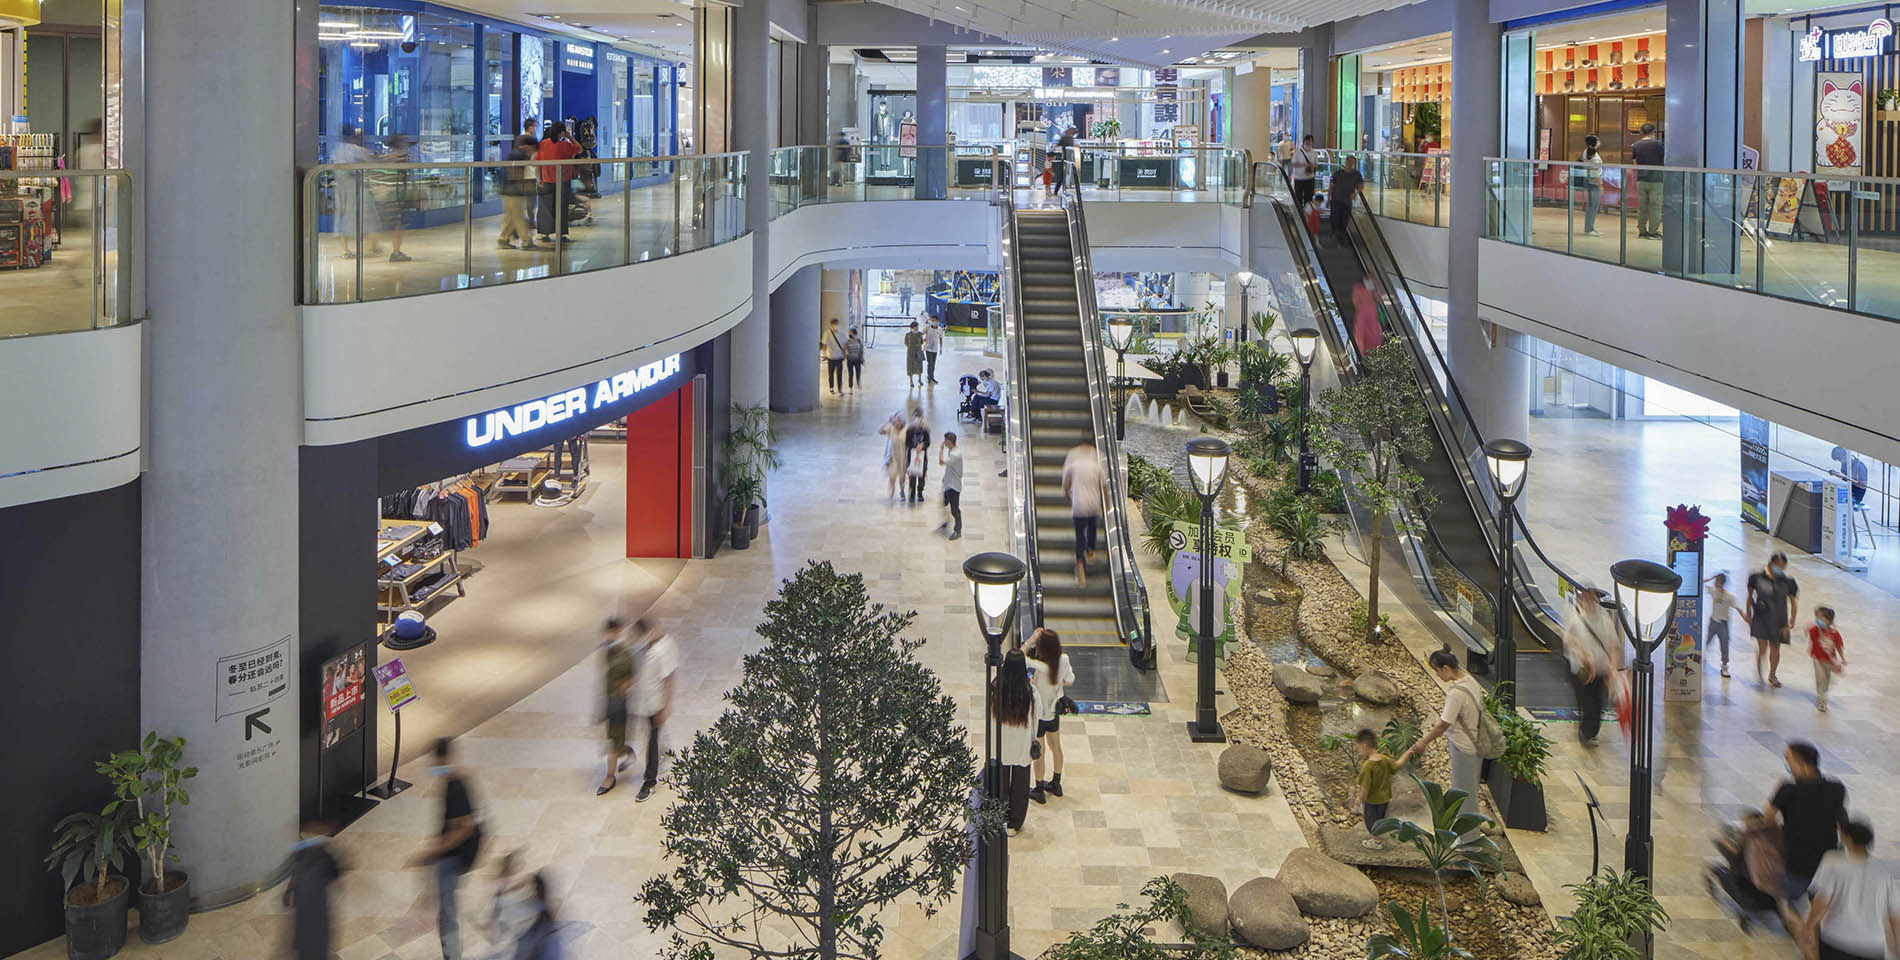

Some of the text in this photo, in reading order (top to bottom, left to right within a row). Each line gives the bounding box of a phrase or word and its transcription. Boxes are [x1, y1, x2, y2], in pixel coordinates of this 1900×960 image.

[467, 353, 680, 447] UNDER ARMOUR
[1188, 525, 1236, 545] 加会员
[330, 685, 358, 708] 新品上市
